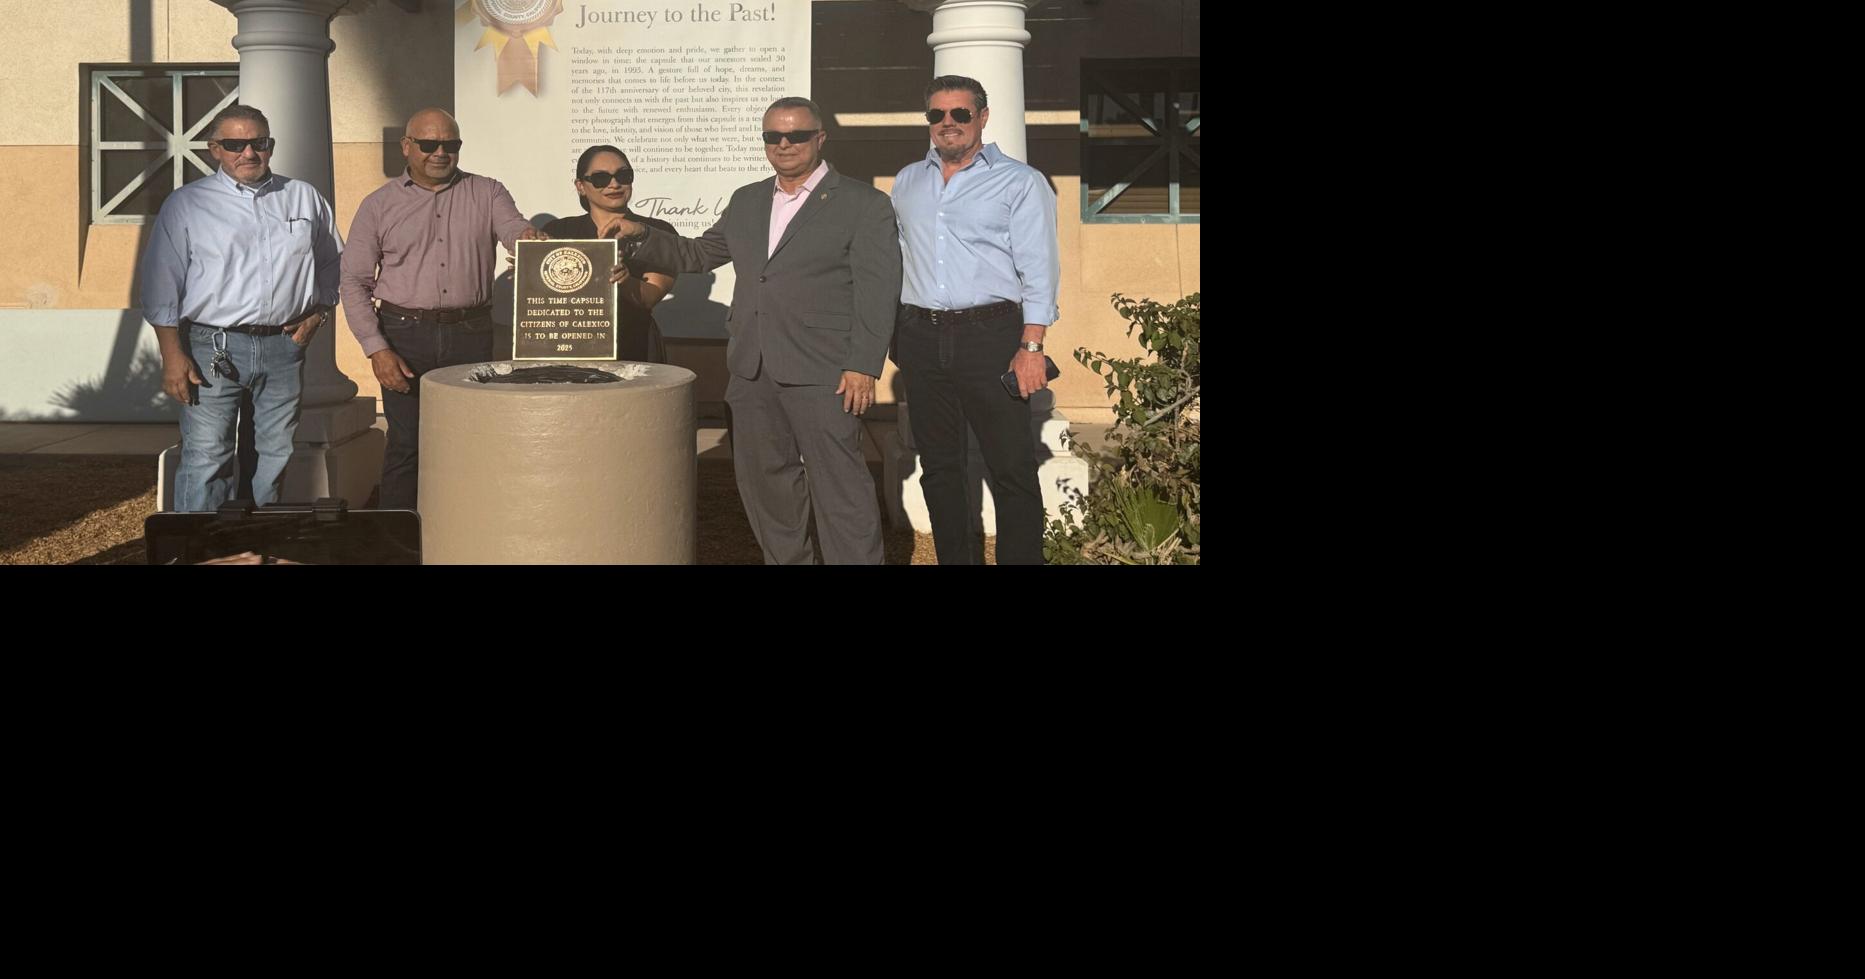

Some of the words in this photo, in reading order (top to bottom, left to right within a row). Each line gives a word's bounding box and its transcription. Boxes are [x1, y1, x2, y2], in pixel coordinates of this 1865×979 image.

[576, 4, 657, 29] Journey
[664, 8, 682, 22] to
[690, 3, 720, 22] the
[729, 2, 776, 22] Past!
[572, 46, 593, 56] Today,
[616, 46, 633, 56] deep
[686, 45, 707, 55] pride,
[724, 45, 745, 55] gather
[760, 46, 777, 54] open
[614, 56, 632, 64] time;
[651, 56, 676, 65] capsule
[571, 68, 588, 76] years
[593, 68, 607, 76] ago,
[658, 66, 682, 75] gesture
[715, 65, 735, 75] hope,
[740, 65, 767, 73] dreams,
[710, 75, 729, 85] today.
[621, 86, 658, 95] anniversary
[718, 85, 732, 95] city,
[585, 96, 600, 106] only
[675, 96, 689, 105] past
[722, 95, 748, 105] inspires
[722, 104, 740, 114] Every
[571, 118, 588, 126] every
[591, 116, 630, 125] photograph
[648, 117, 675, 125] emerges
[710, 114, 736, 124] capsule
[593, 126, 608, 134] love,
[571, 136, 610, 146] community.
[674, 135, 688, 145] only
[695, 144, 723, 154] together.
[727, 144, 747, 154] Today
[646, 155, 670, 165] history
[634, 165, 648, 173] oice,
[665, 166, 682, 174] every
[635, 197, 708, 218] Thank
[669, 220, 699, 229] oining
